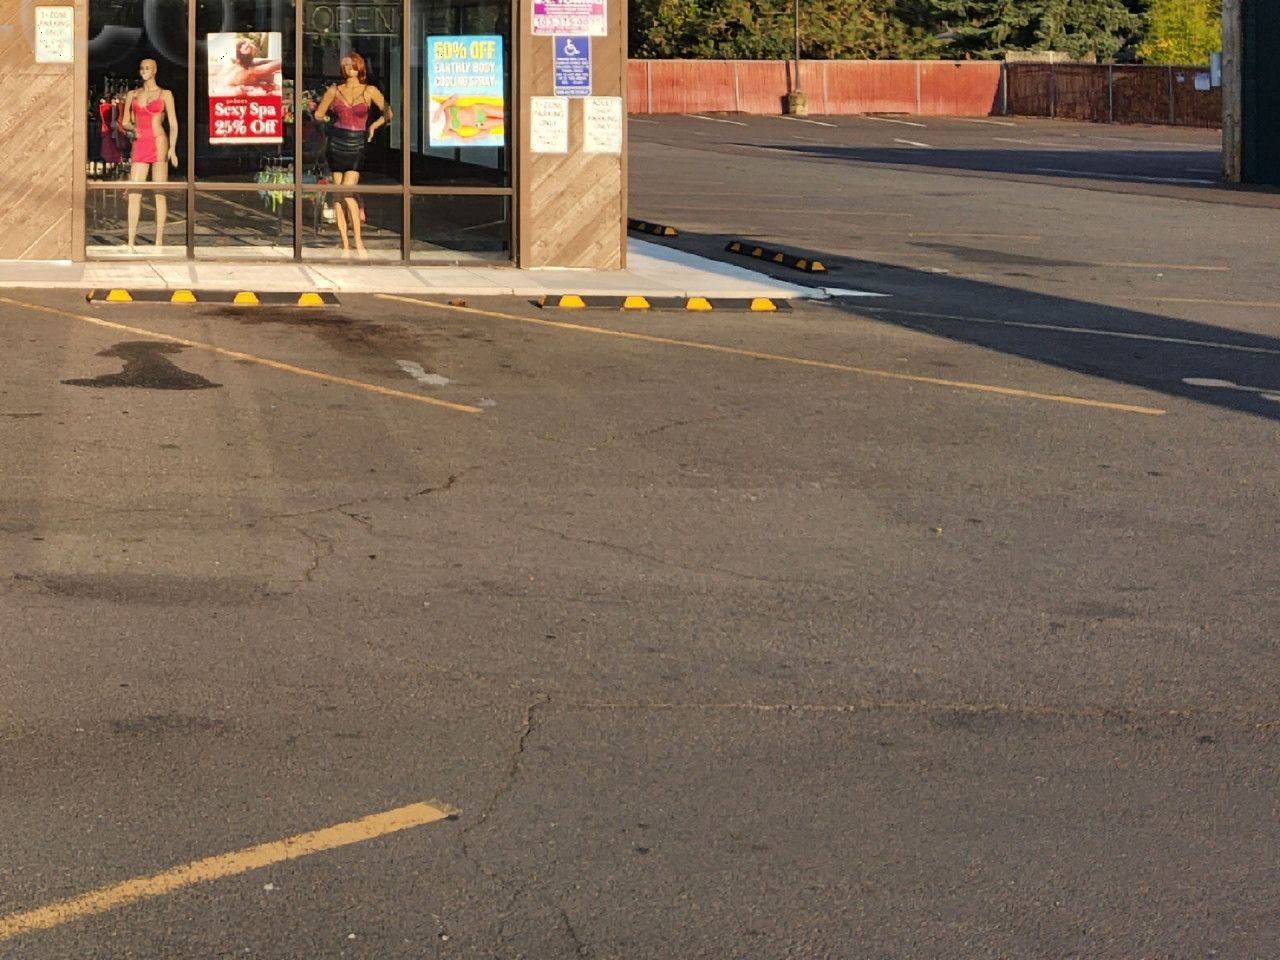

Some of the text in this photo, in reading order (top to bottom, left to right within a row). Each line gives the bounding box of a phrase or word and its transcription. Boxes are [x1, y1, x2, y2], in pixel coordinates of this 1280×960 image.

[312, 5, 394, 33] OPEN
[470, 41, 496, 59] OFF
[214, 102, 277, 119] Sexy Spa
[214, 119, 279, 136] 25% Off
